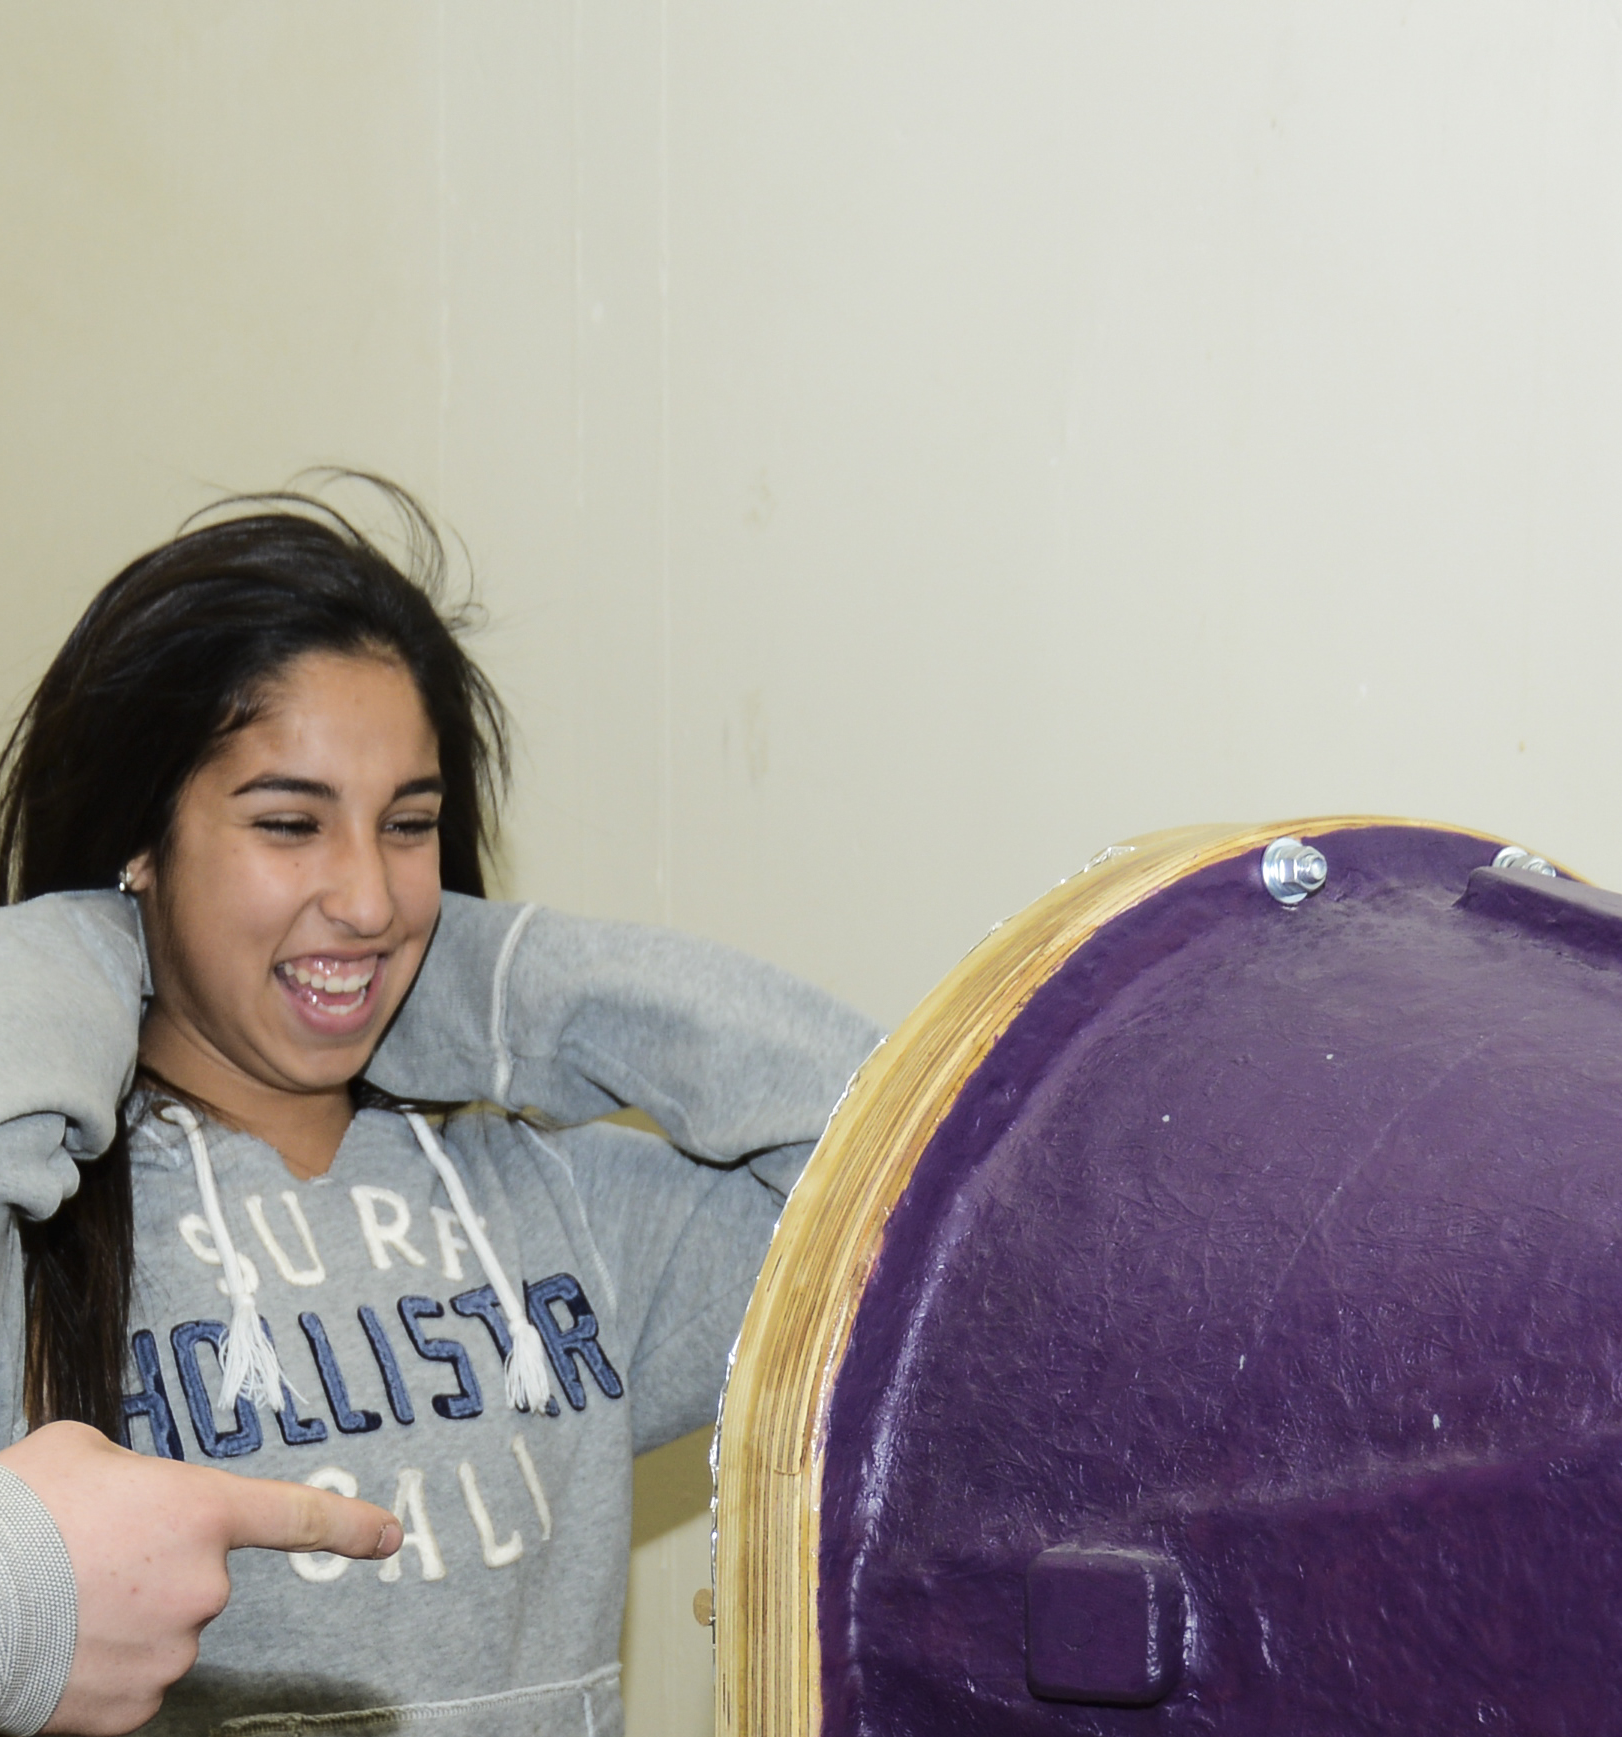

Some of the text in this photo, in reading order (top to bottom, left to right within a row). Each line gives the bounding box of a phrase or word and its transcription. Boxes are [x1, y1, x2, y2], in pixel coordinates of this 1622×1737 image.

[178, 1185, 486, 1296] SURF
[121, 1272, 624, 1462] HOLLISTR
[288, 1434, 552, 1583] CALI
